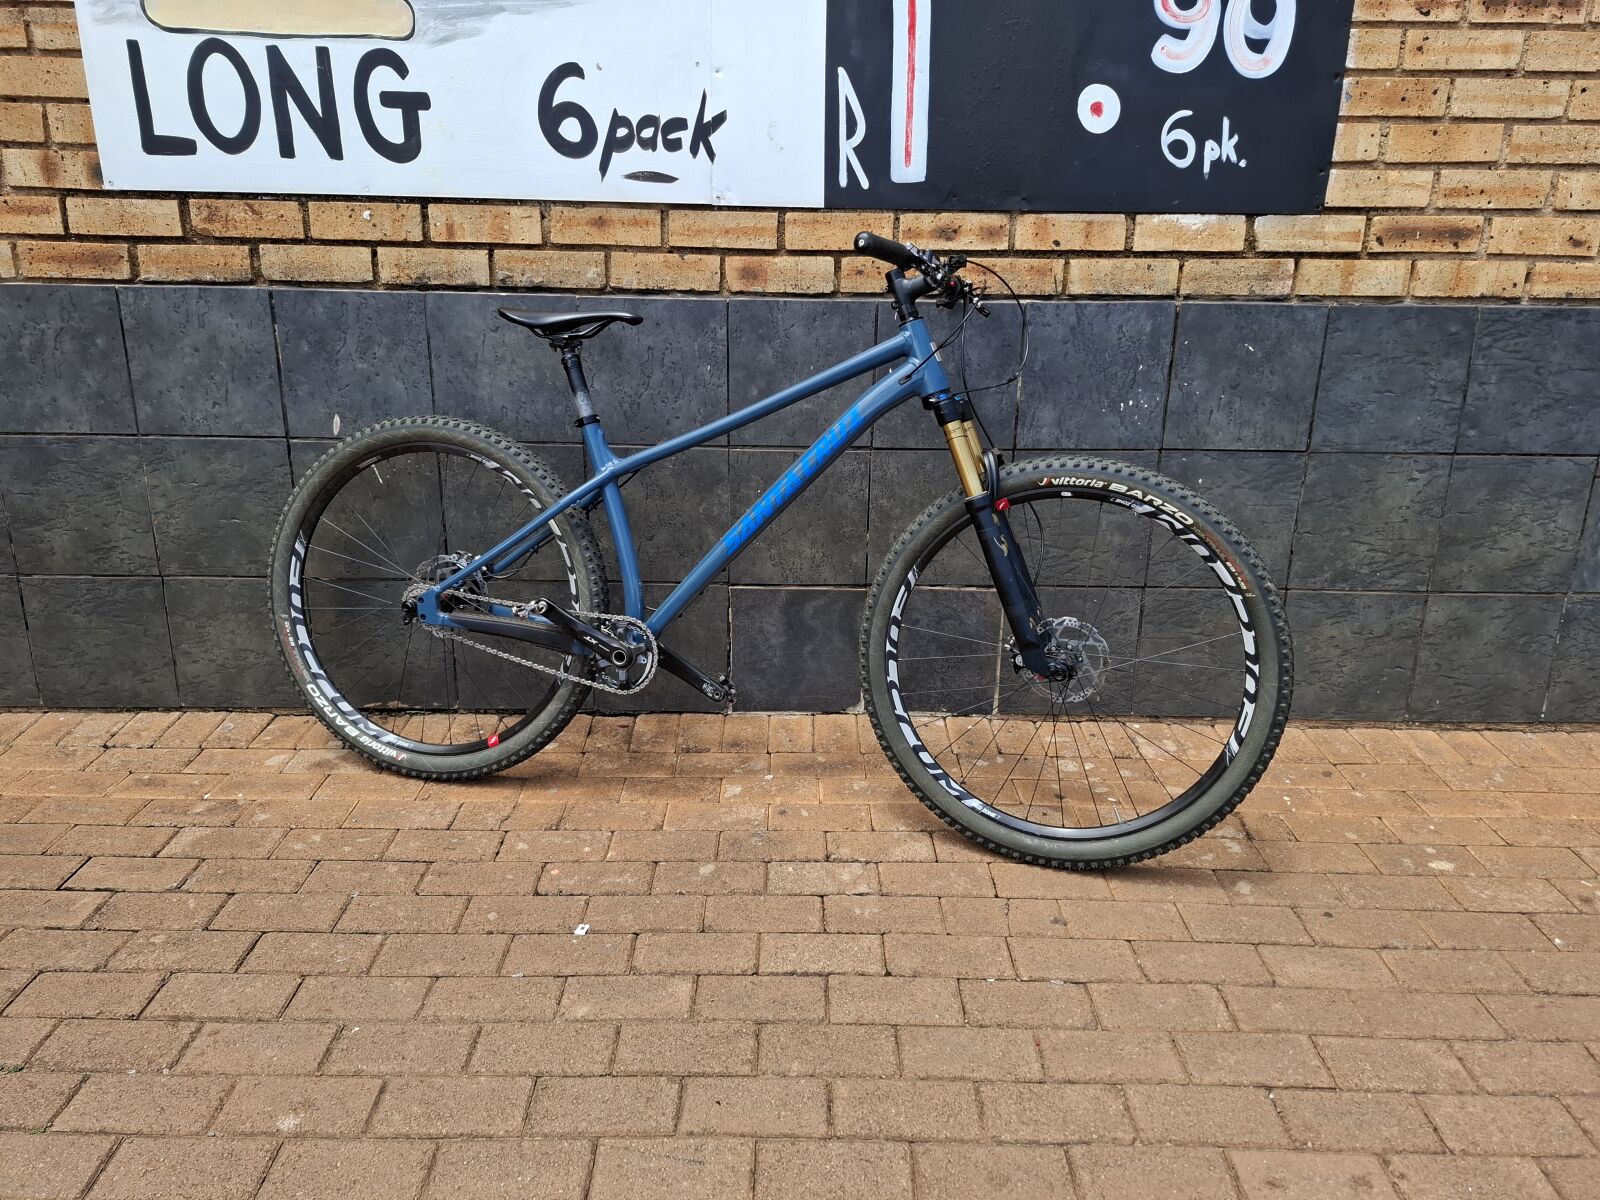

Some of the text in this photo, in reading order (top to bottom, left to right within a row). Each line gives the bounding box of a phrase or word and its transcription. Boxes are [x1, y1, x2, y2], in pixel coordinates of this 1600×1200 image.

[125, 37, 431, 164] LONG
[837, 66, 870, 190] R
[1051, 476, 1194, 525] vittoria BARZO
[306, 683, 398, 758] vittoria BARZO
